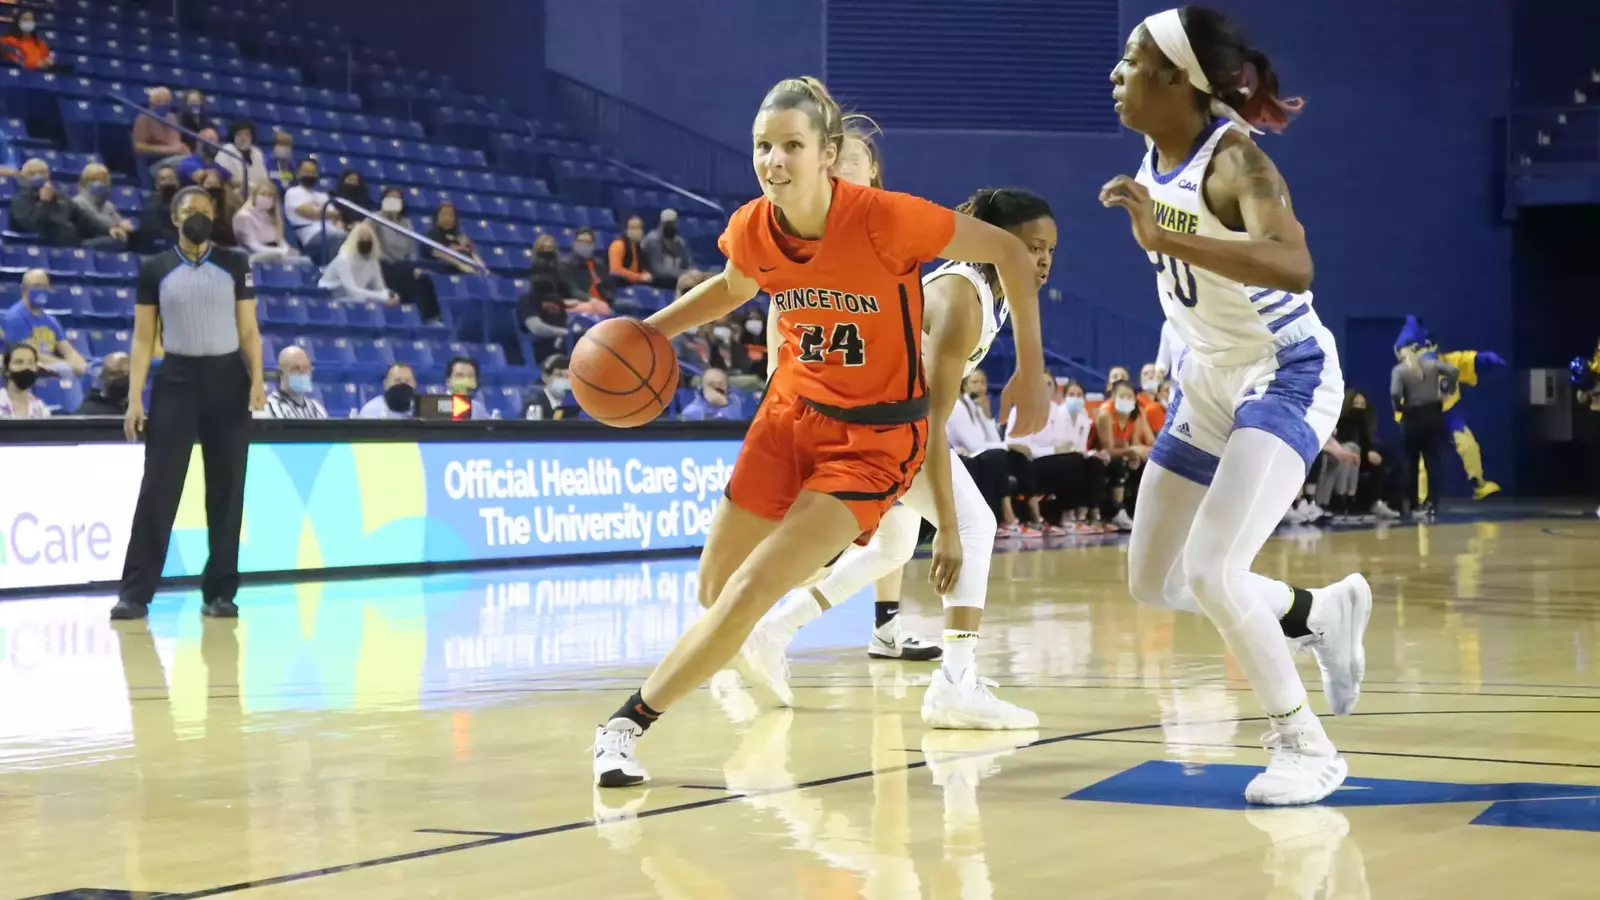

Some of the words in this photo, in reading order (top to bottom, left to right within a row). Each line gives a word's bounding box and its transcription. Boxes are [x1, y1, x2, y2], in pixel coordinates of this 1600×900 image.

[1178, 179, 1197, 192] CAA
[1152, 199, 1199, 235] WARE
[773, 288, 880, 313] RINCETON
[795, 321, 865, 367] 24
[445, 460, 538, 500] Official
[541, 458, 622, 497] Health
[625, 458, 678, 494] Care
[479, 506, 531, 545] The
[534, 502, 652, 548] University
[657, 501, 680, 536] of
